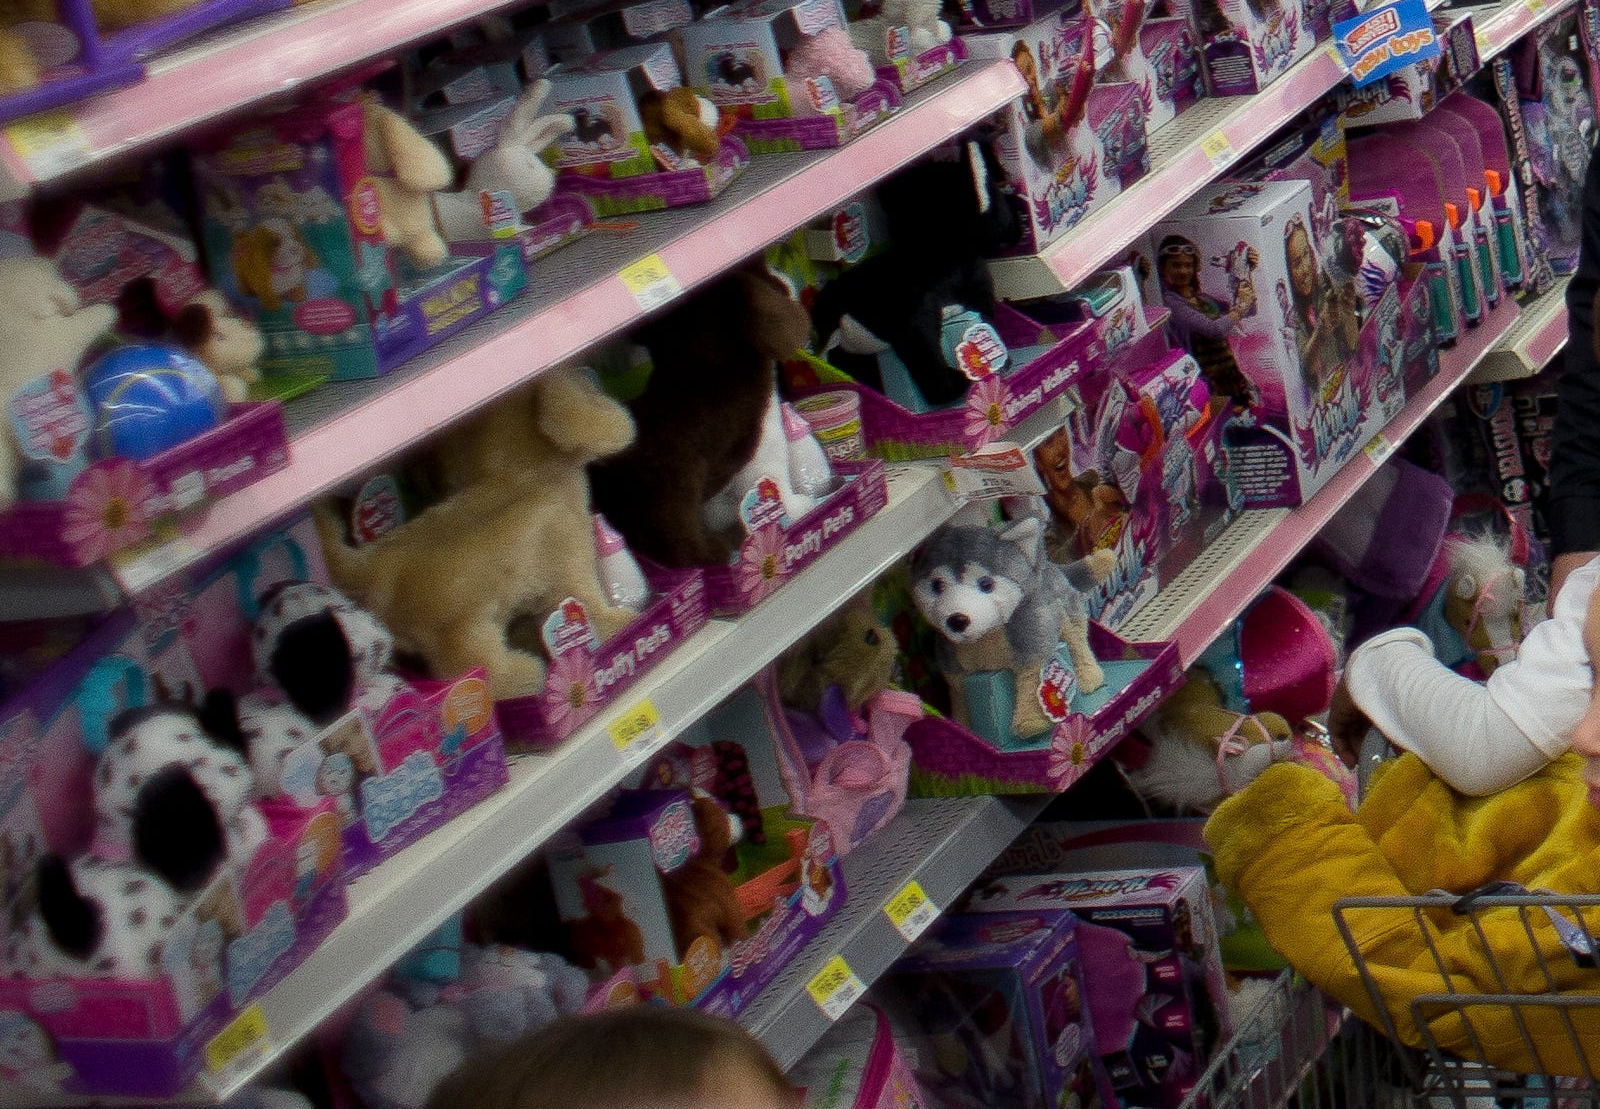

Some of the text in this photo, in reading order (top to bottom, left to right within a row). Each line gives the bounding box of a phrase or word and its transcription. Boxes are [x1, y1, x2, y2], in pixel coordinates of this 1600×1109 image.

[1351, 29, 1433, 80] new toys
[822, 506, 854, 538] Pets
[635, 623, 672, 661] Pets
